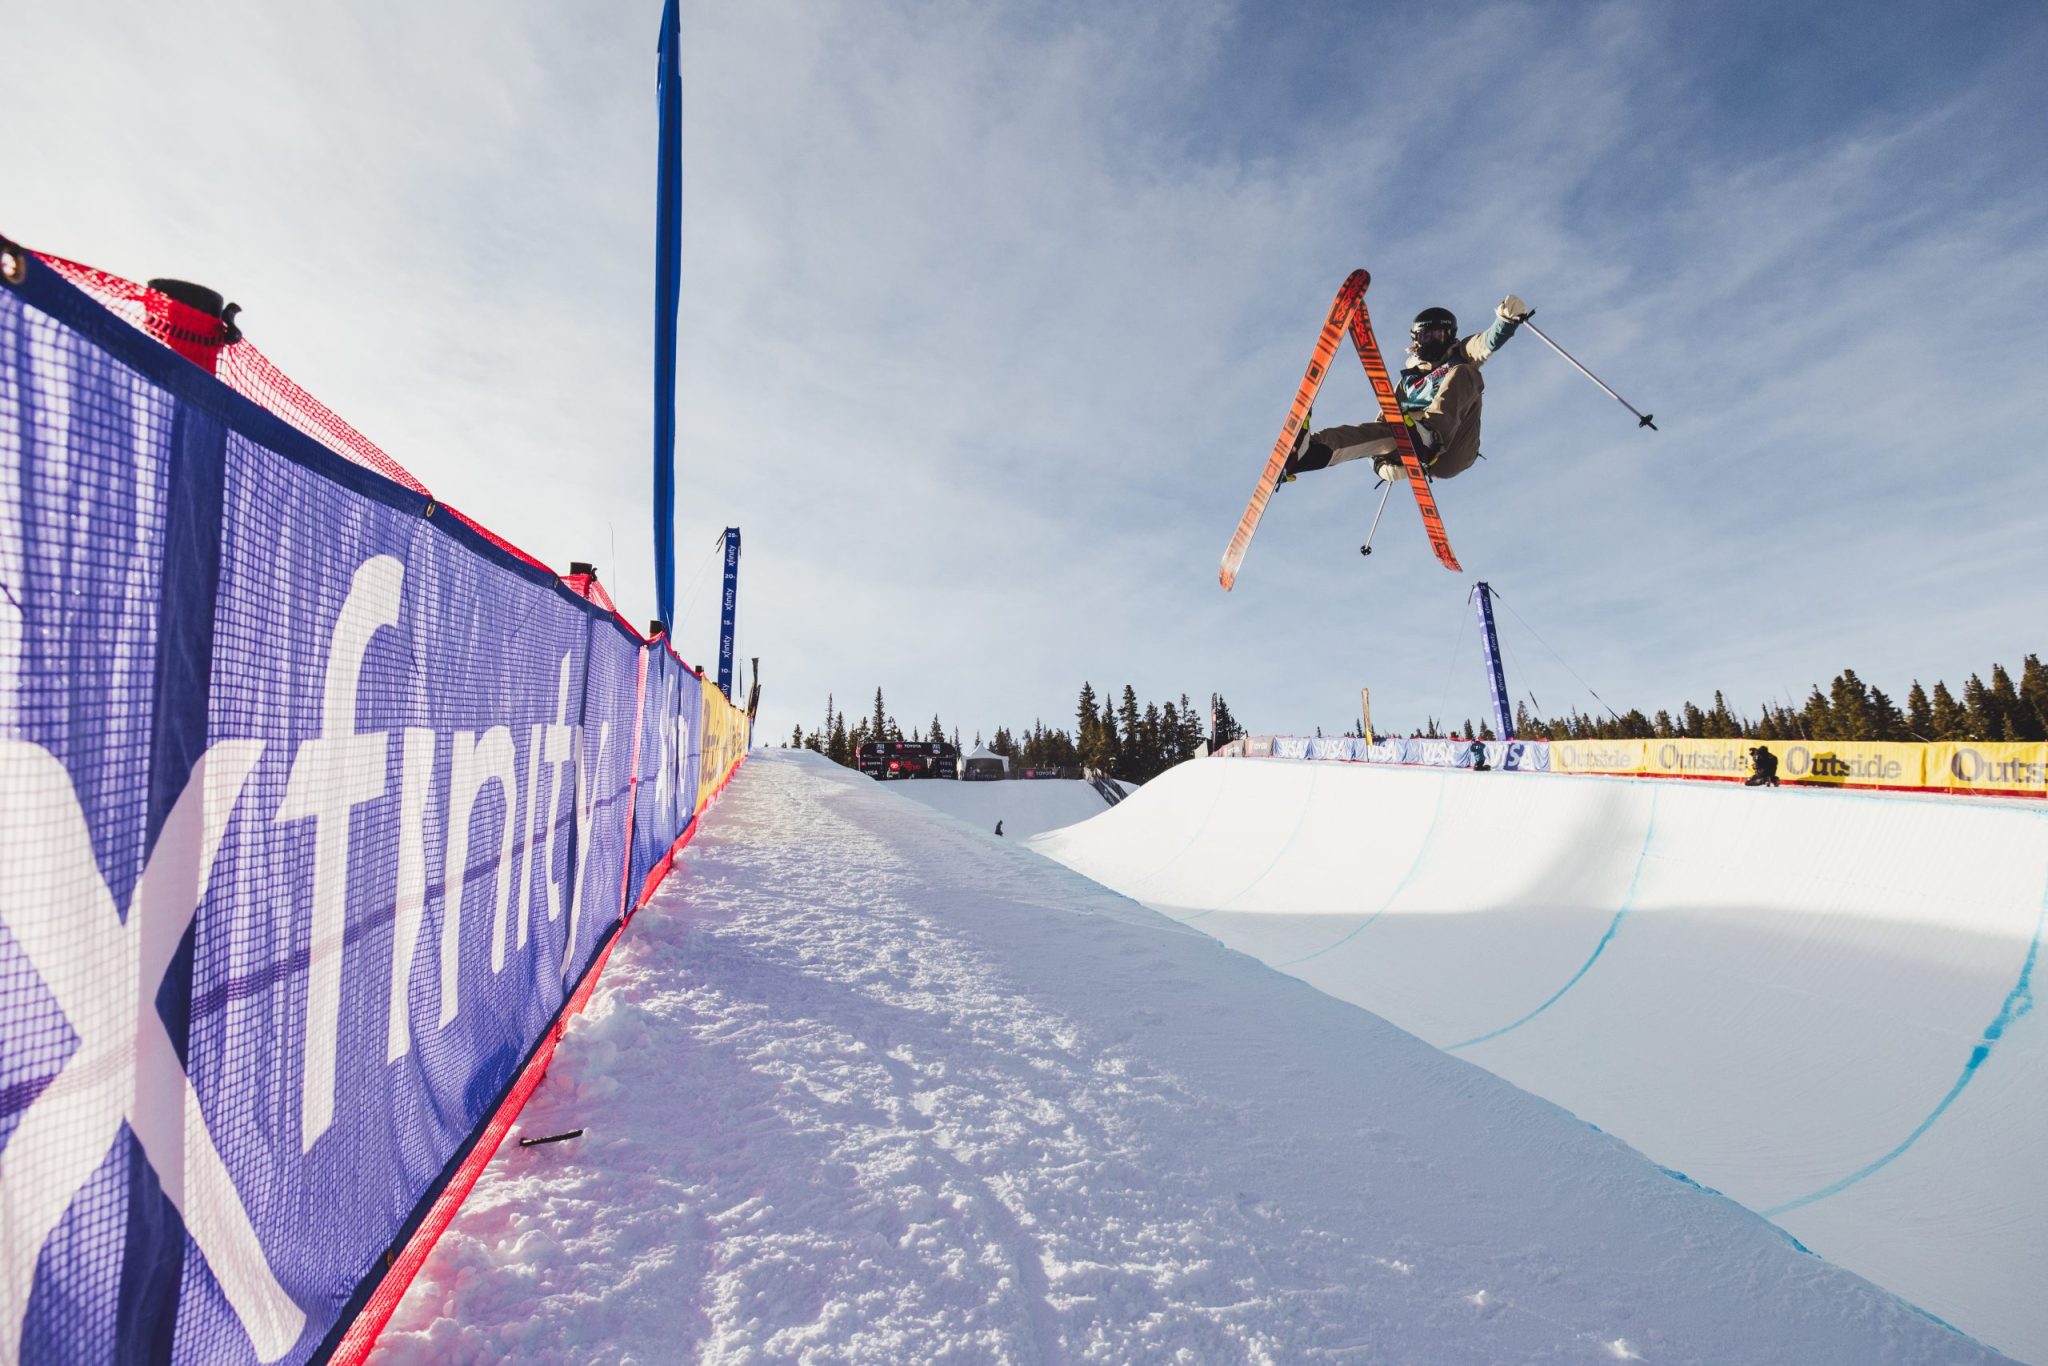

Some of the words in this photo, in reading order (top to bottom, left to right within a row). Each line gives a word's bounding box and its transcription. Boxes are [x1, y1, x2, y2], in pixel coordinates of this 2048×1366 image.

[727, 544, 736, 567] xfinity
[724, 587, 735, 611] xfinity
[722, 635, 732, 658] xfinity
[1485, 743, 1536, 770] VISA
[1560, 745, 1632, 768] Outside
[1658, 743, 1749, 772] Outside
[1786, 745, 1902, 779] Outside
[0, 552, 610, 1364] xfinity
